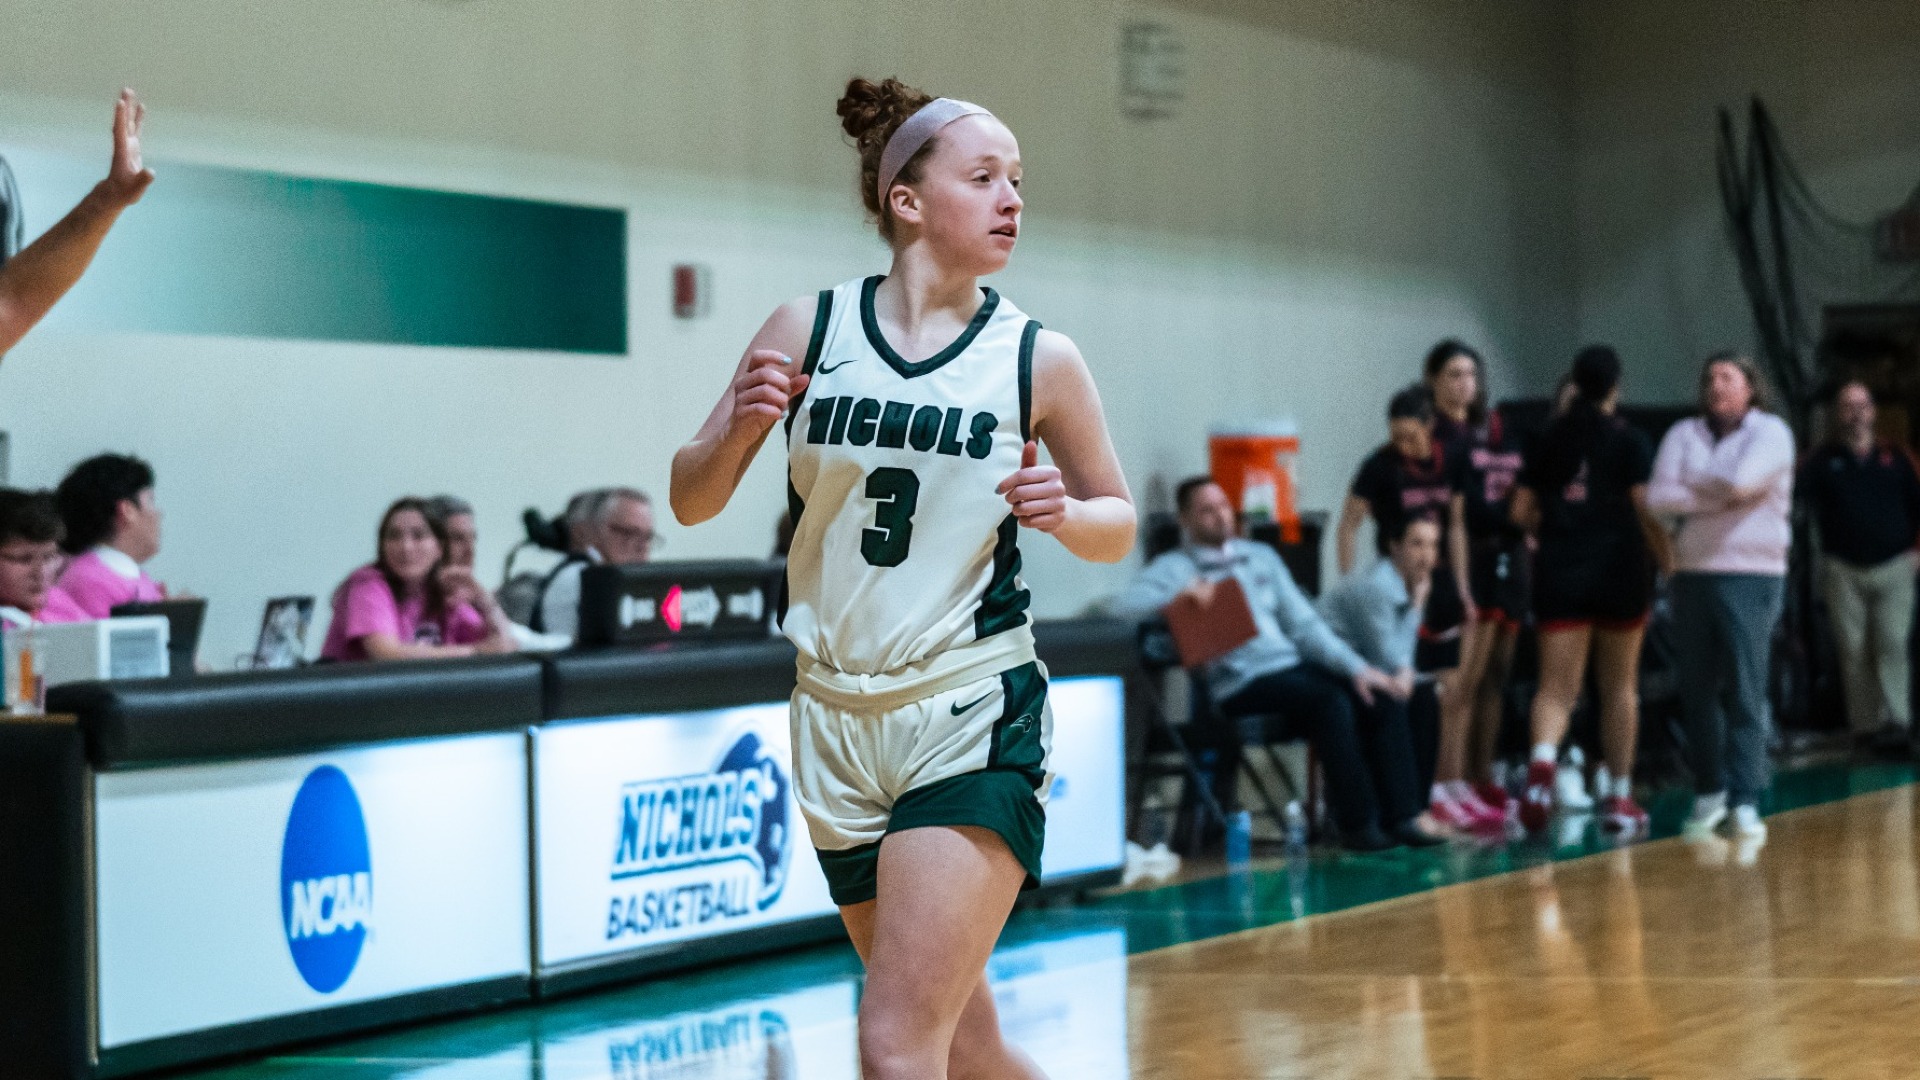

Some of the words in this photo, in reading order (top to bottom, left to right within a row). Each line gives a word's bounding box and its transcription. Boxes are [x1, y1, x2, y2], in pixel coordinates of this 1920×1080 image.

[807, 396, 998, 460] NICHOLS
[860, 466, 920, 568] 3
[615, 779, 757, 865] NICHOLS
[291, 872, 373, 939] NCAA
[607, 875, 750, 939] BASKETBALL
